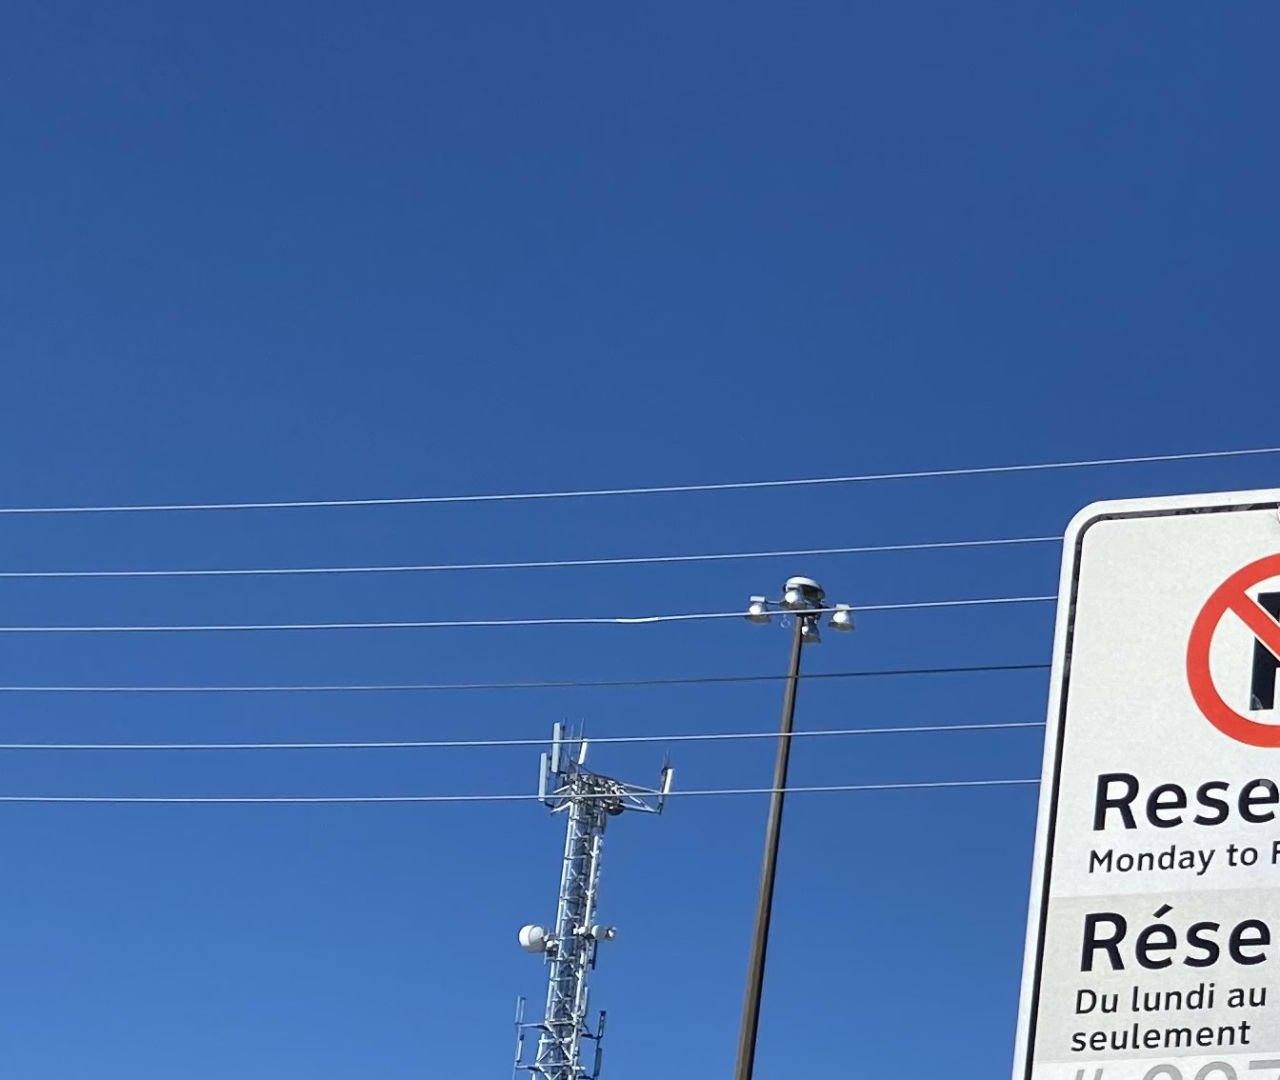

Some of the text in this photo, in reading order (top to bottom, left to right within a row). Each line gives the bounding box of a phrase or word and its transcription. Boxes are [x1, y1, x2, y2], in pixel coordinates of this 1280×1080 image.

[1090, 846, 1215, 875] Monday
[1227, 845, 1257, 866] to
[1076, 990, 1118, 1014] Du
[1133, 983, 1213, 1011] lundi
[1228, 988, 1266, 1007] au
[1072, 1021, 1250, 1051] seulement
